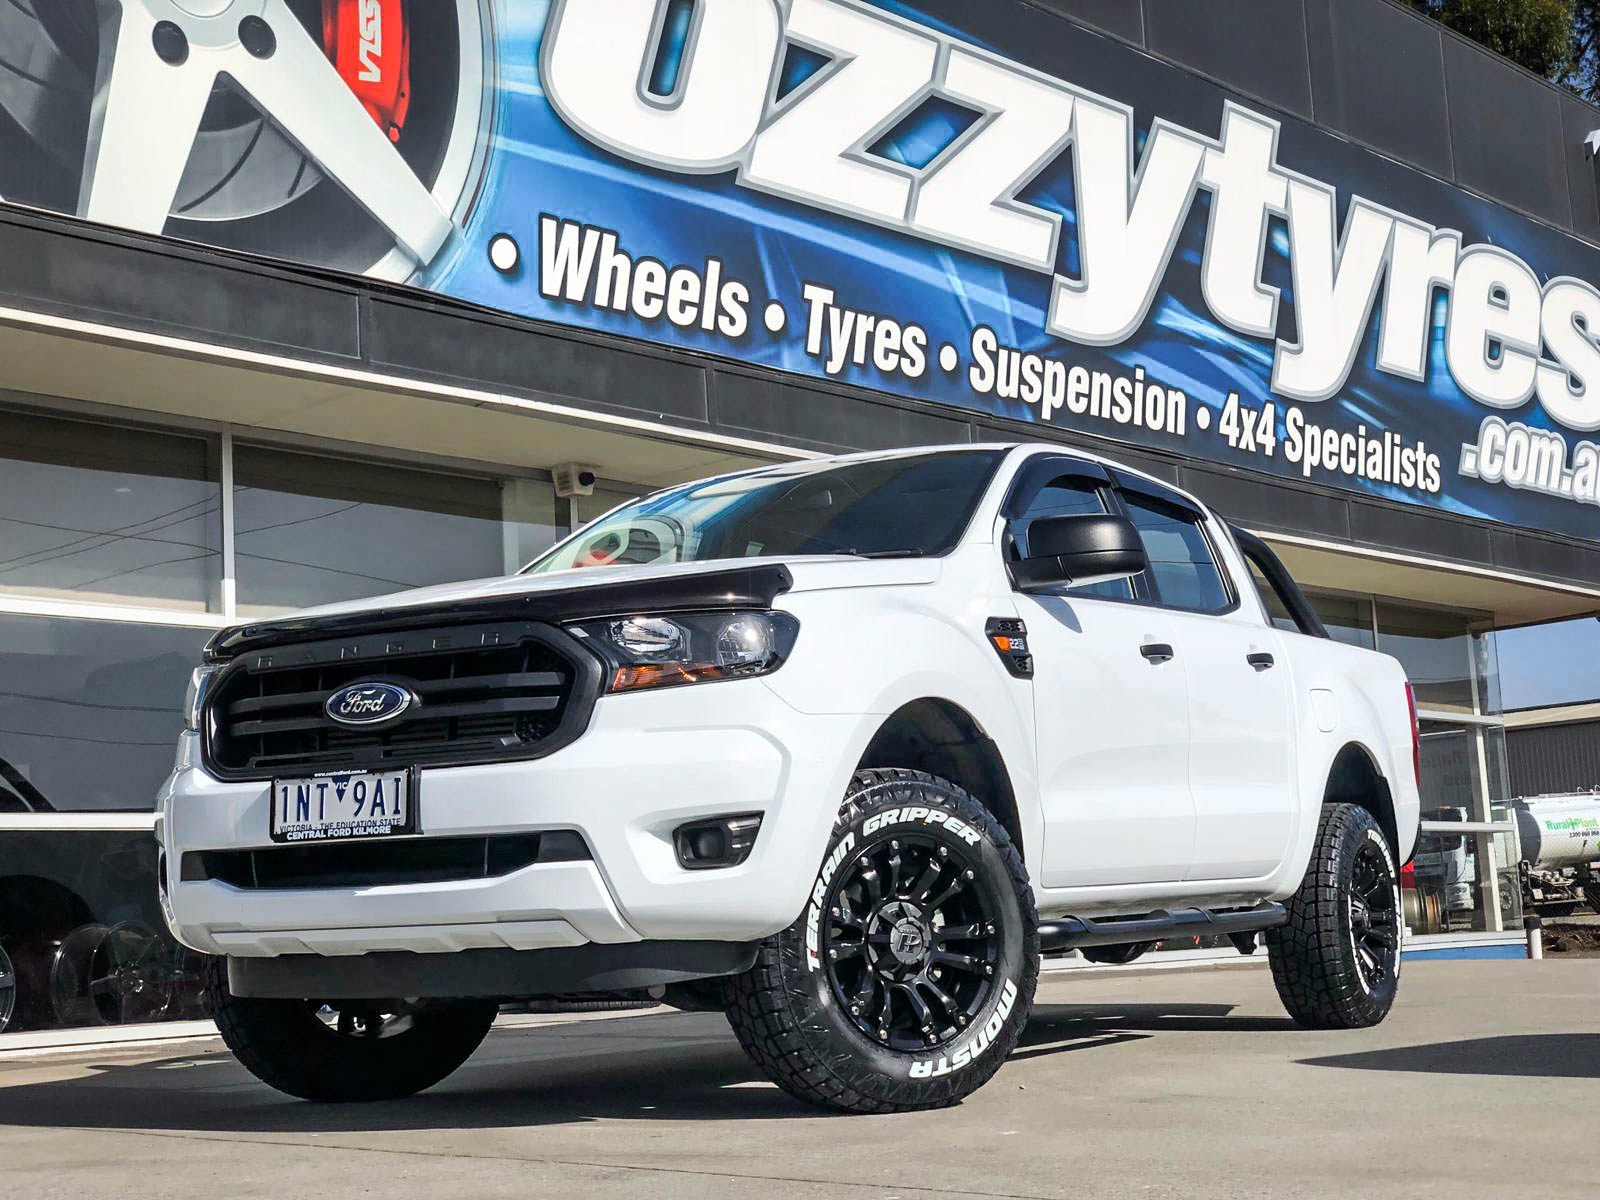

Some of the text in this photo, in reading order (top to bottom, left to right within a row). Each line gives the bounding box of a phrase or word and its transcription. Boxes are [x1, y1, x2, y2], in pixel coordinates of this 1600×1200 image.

[538, 214, 1441, 493] Wheels Tyres Suspension 4x4 Specialists
[1459, 415, 1600, 506] .com.a
[256, 631, 502, 668] RNGER
[339, 688, 386, 714] Ford
[282, 783, 329, 823] 1NT
[335, 781, 348, 790] VIC
[286, 825, 392, 841] CENTRAL FORD KILMORE
[378, 817, 401, 826] STATE
[805, 807, 982, 973] TERRAIN GRIPPER
[908, 978, 1018, 1079] MONSTA
